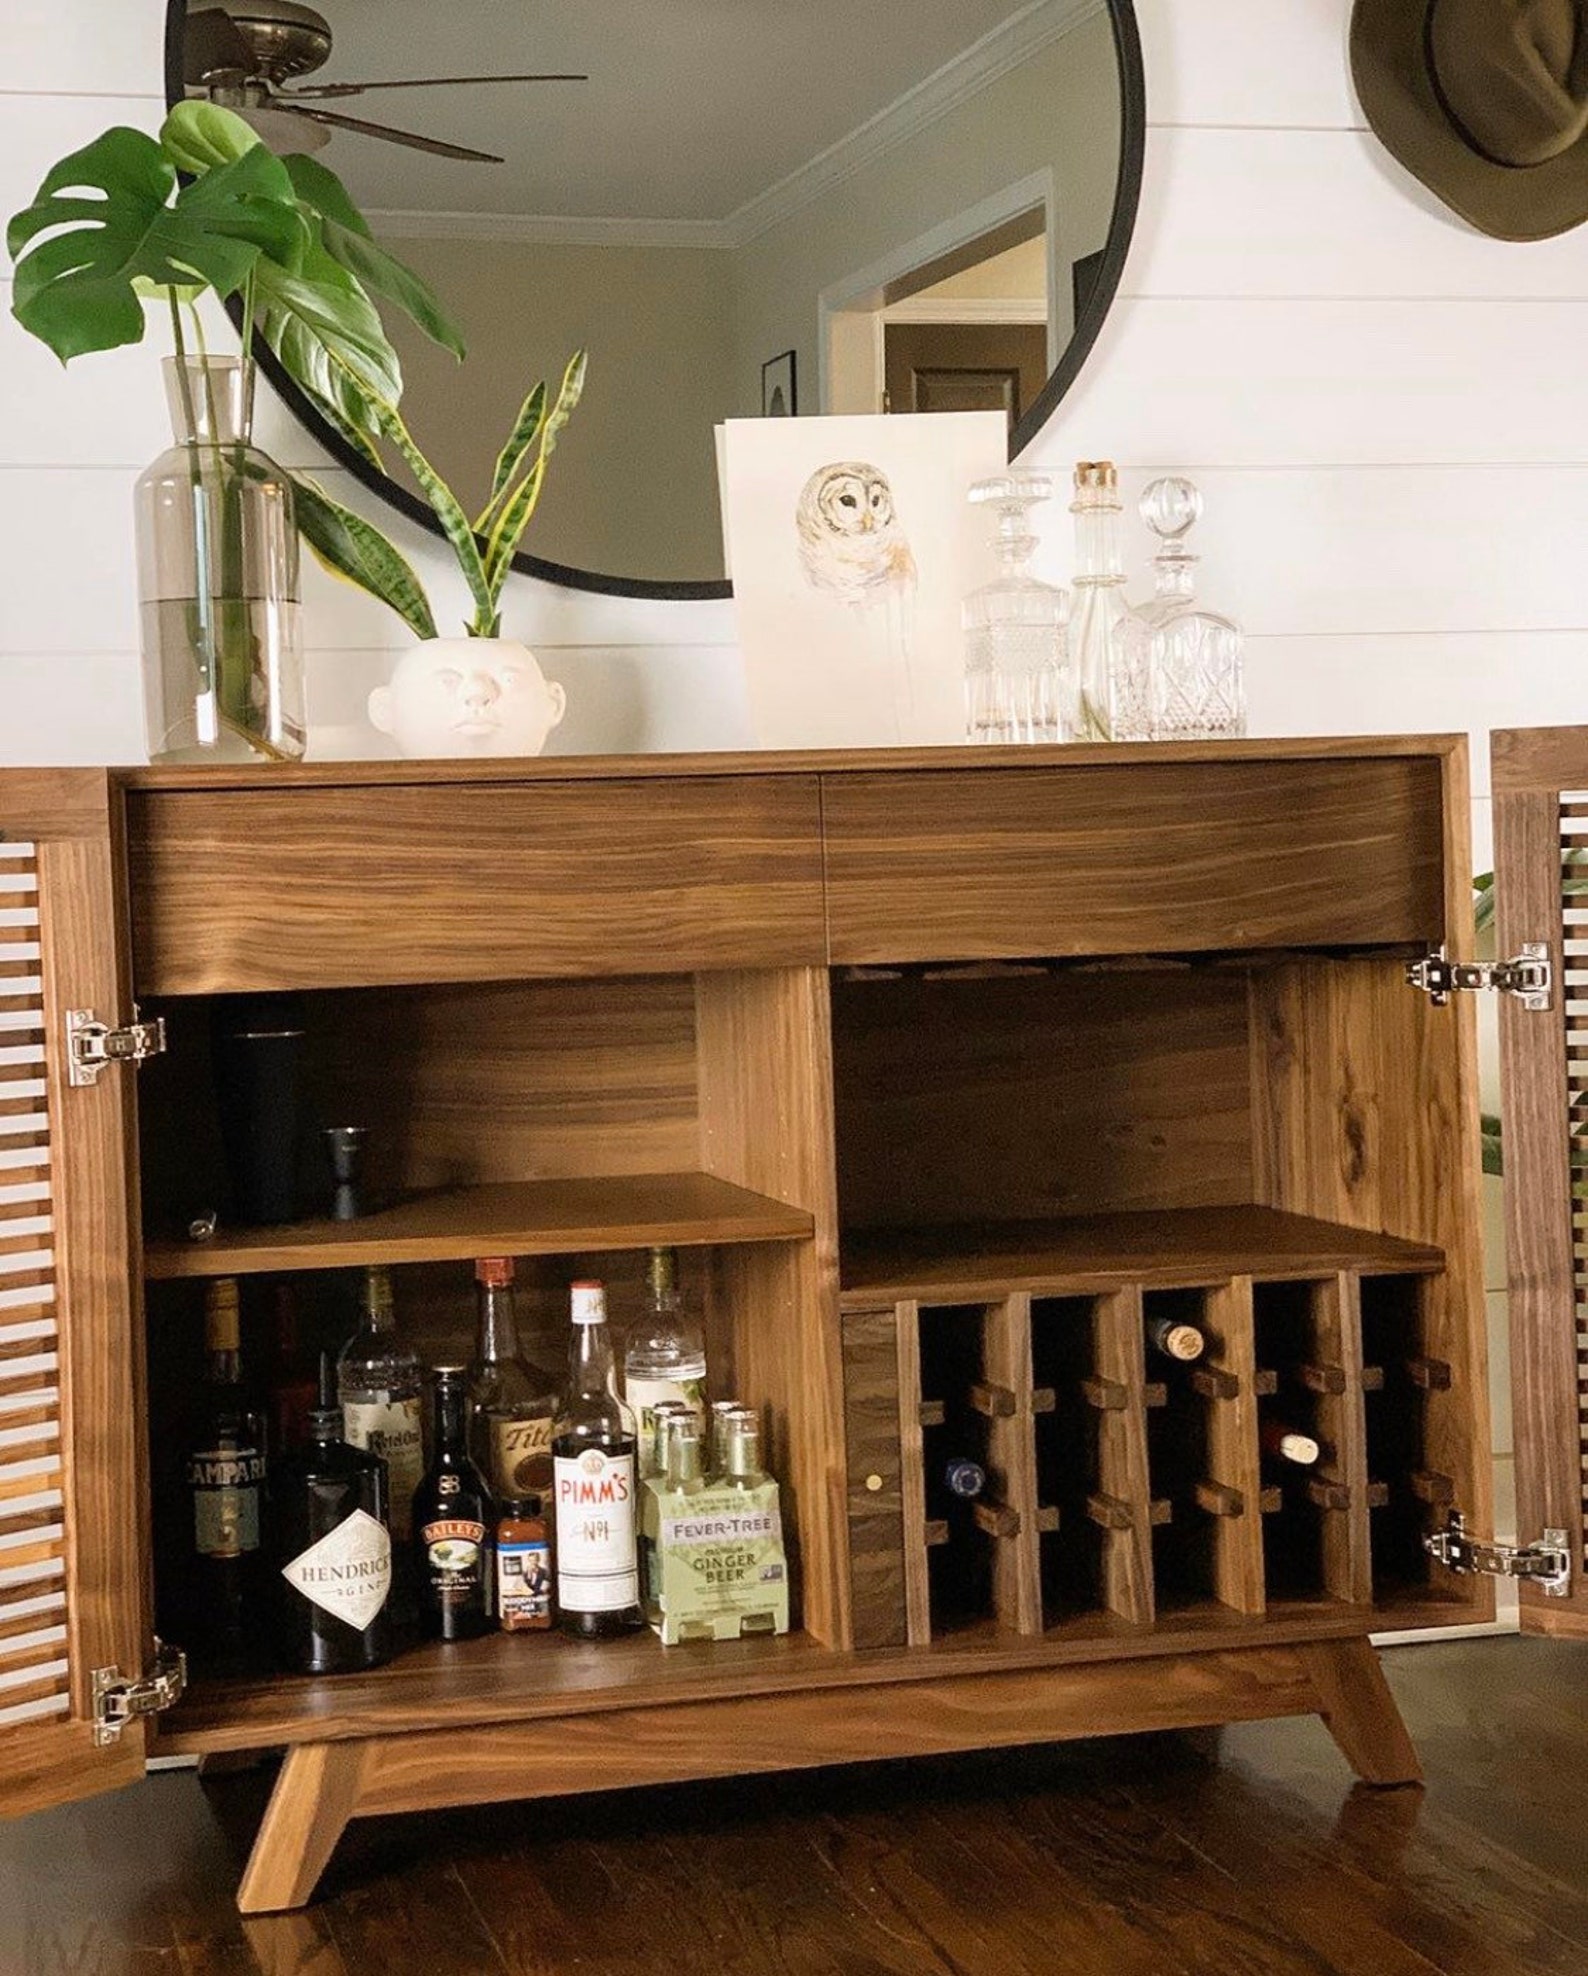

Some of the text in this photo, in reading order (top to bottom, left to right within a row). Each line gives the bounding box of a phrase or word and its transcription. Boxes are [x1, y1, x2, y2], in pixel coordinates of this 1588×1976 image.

[561, 1473, 628, 1504] PIMM'S
[424, 1522, 480, 1541] BAILEYS
[673, 1518, 772, 1539] FEVER-TREE
[692, 1553, 756, 1571] GINGER
[705, 1569, 745, 1583] BEER
